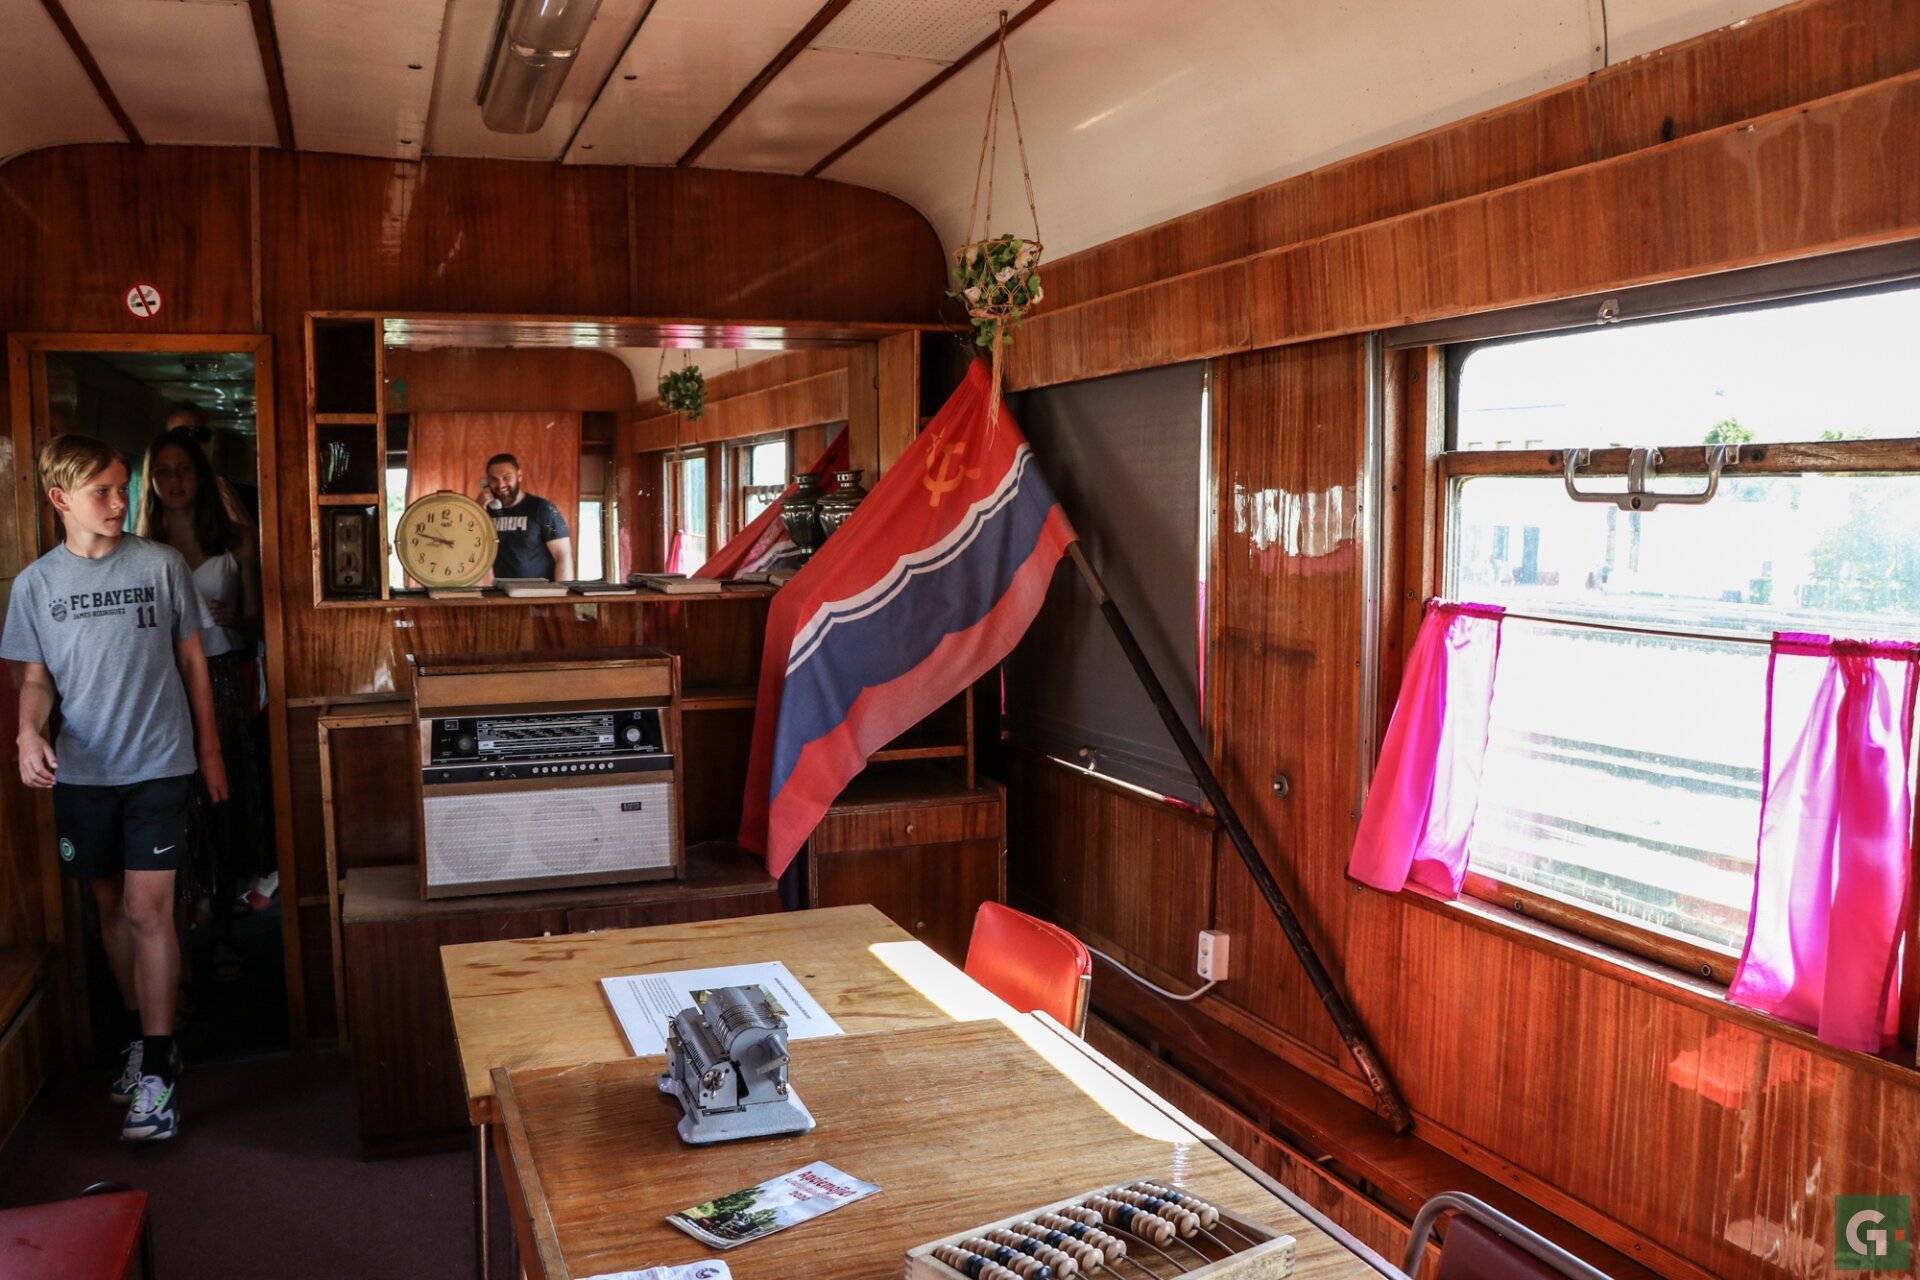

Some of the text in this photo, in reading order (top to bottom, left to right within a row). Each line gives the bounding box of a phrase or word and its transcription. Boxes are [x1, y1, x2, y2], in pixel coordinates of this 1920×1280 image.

[427, 513, 434, 523] 11
[441, 509, 451, 520] 12
[459, 513, 463, 523] 1
[416, 522, 425, 533] 10
[468, 520, 475, 531] 2
[411, 537, 419, 547] 9
[474, 537, 481, 548] 3
[418, 552, 425, 563] 8
[468, 554, 475, 563] 4
[430, 562, 436, 573] 7
[444, 566, 451, 576] 6
[457, 563, 464, 573] 5
[70, 586, 155, 610] FC BAYERN
[137, 605, 157, 628] 11
